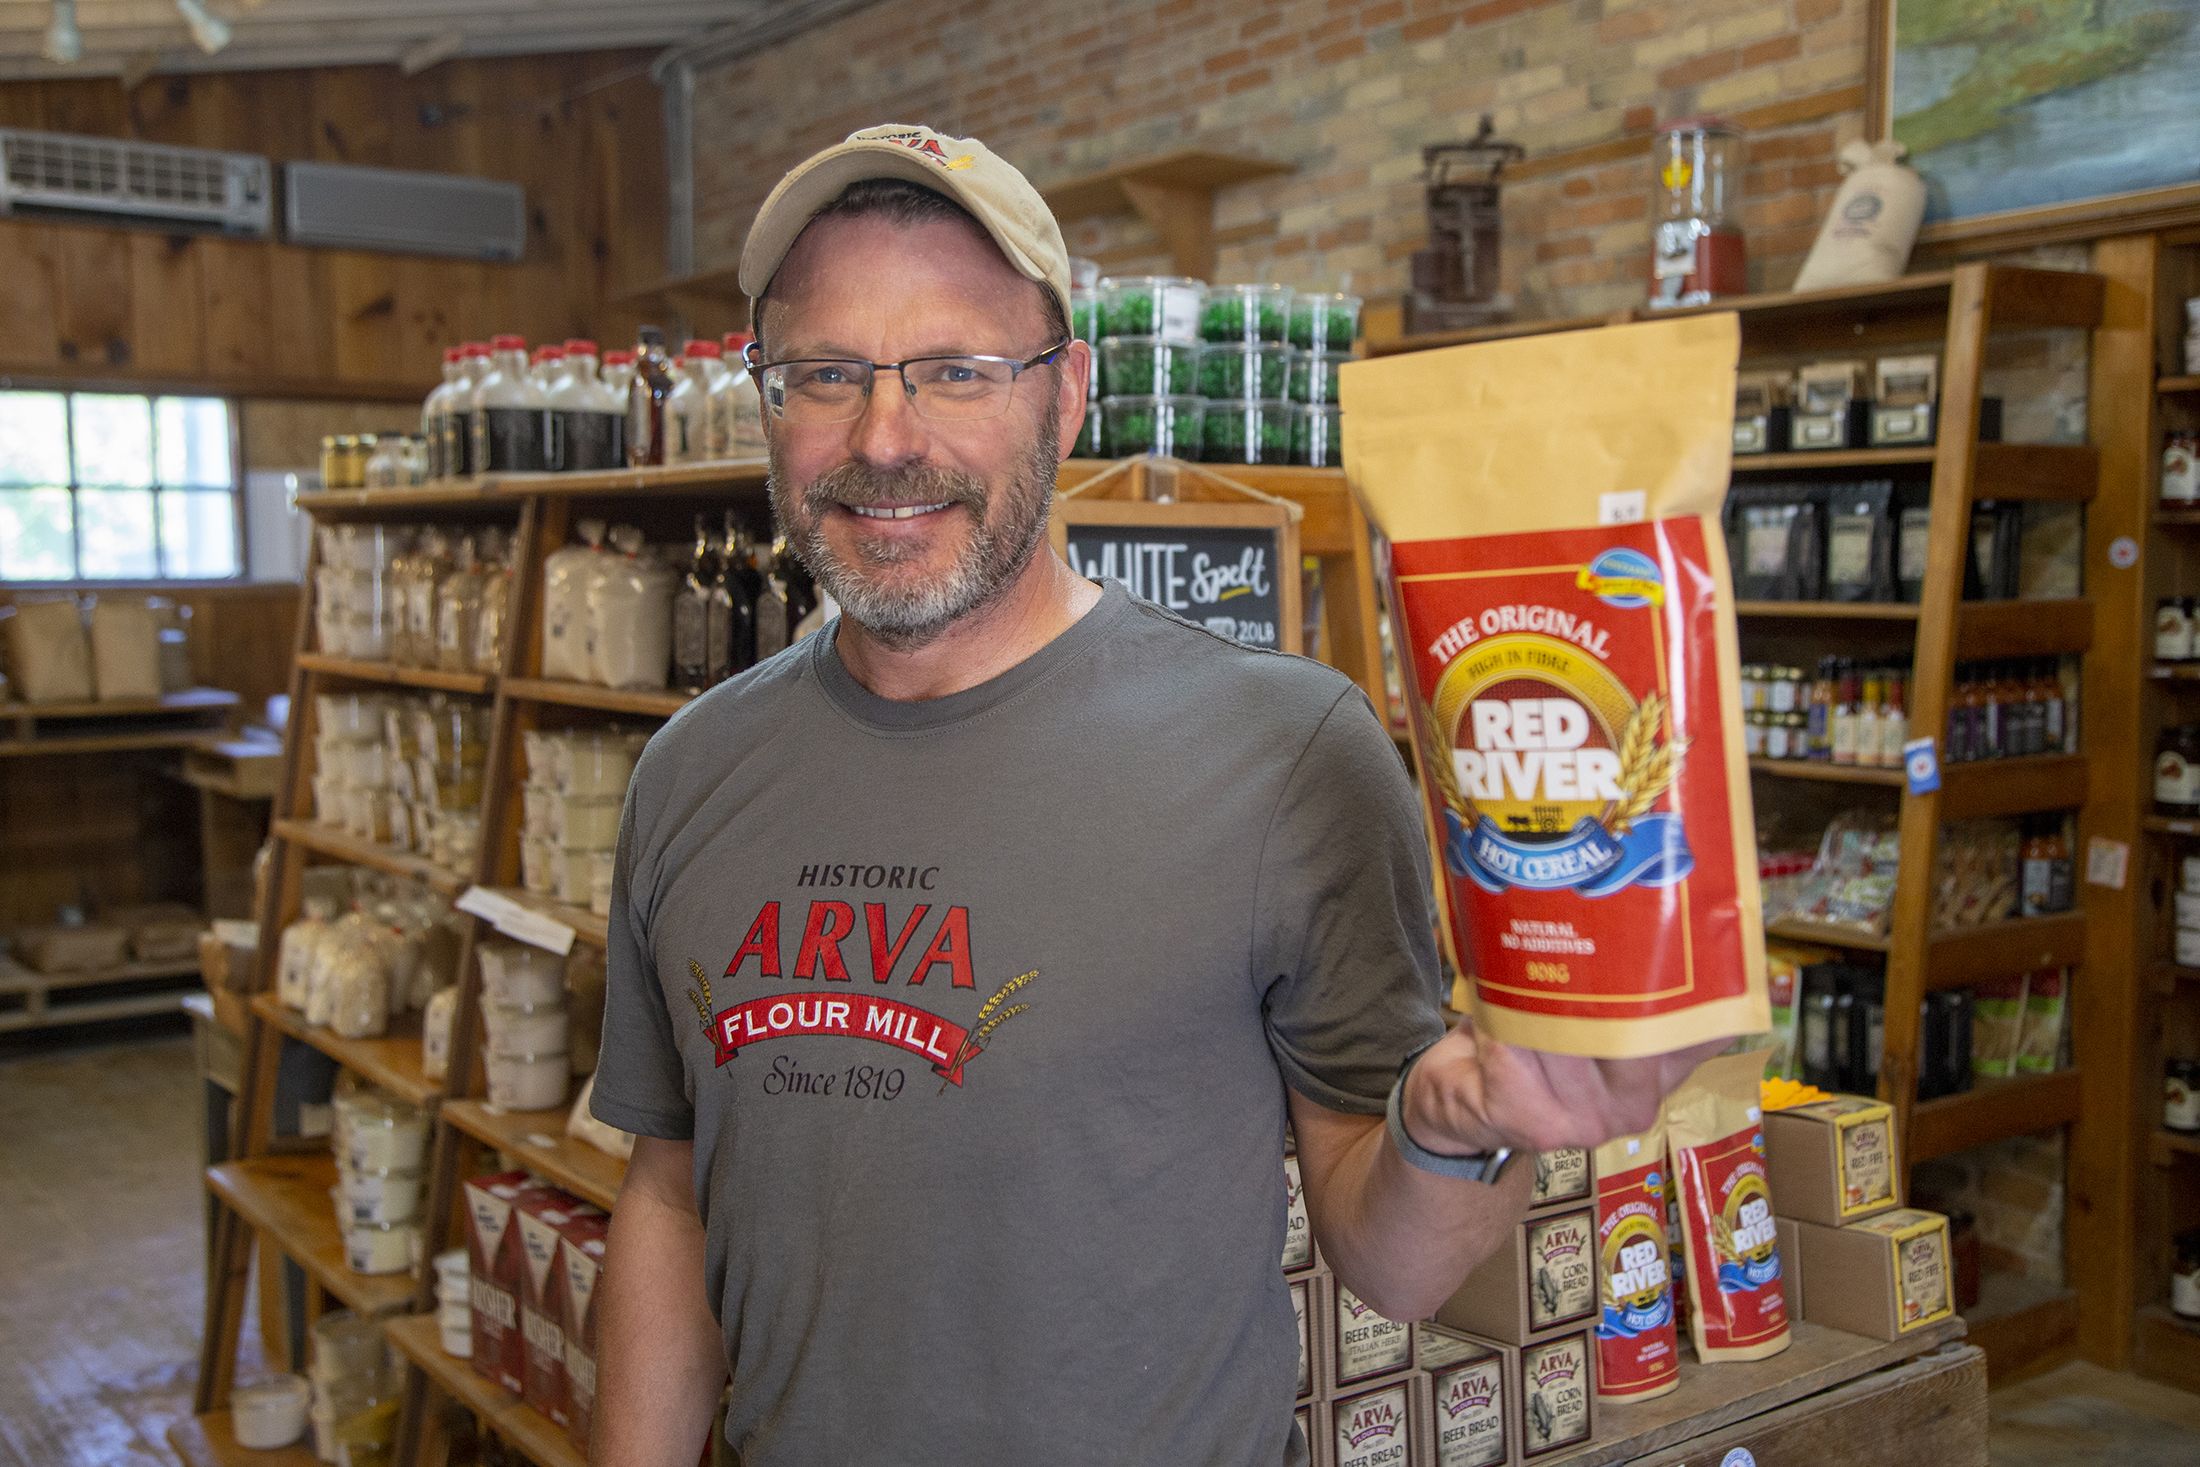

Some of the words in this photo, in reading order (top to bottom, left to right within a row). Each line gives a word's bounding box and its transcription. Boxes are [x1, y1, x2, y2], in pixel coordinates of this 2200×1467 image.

[1068, 543, 1189, 609] WHITE
[1429, 617, 1480, 664] THE
[1479, 604, 1611, 660] ORIGINAL
[1471, 697, 1589, 751] RED
[1453, 748, 1631, 800] RIVER
[1479, 837, 1523, 876] HOT
[1521, 841, 1613, 881] CEREAL
[797, 864, 940, 891] HISTORIC
[723, 899, 977, 992] ARVA
[723, 1001, 851, 1045] FLOUR
[864, 1004, 948, 1060] MILL
[763, 1055, 836, 1097] Since
[843, 1065, 906, 1101] 1819
[1554, 1156, 1583, 1173] BREAD
[1739, 1197, 1769, 1228] RED
[1544, 1228, 1580, 1249] ARVA
[1733, 1215, 1777, 1253] RIVER
[1620, 1239, 1658, 1272] RED
[1562, 1262, 1589, 1280] CORN
[1562, 1275, 1590, 1293] BREAD
[1611, 1259, 1667, 1298] RIVER
[1345, 1326, 1370, 1345] BEER
[1372, 1321, 1405, 1338] BREAD
[1539, 1351, 1574, 1374] ARVA
[1450, 1375, 1490, 1403] ARVA
[1556, 1386, 1582, 1404] CORN
[1352, 1403, 1394, 1432] ARVA
[1556, 1399, 1583, 1418] BREAD
[1443, 1425, 1467, 1445] BEER
[1468, 1415, 1500, 1437] BREAD
[1370, 1444, 1404, 1467] BREAD
